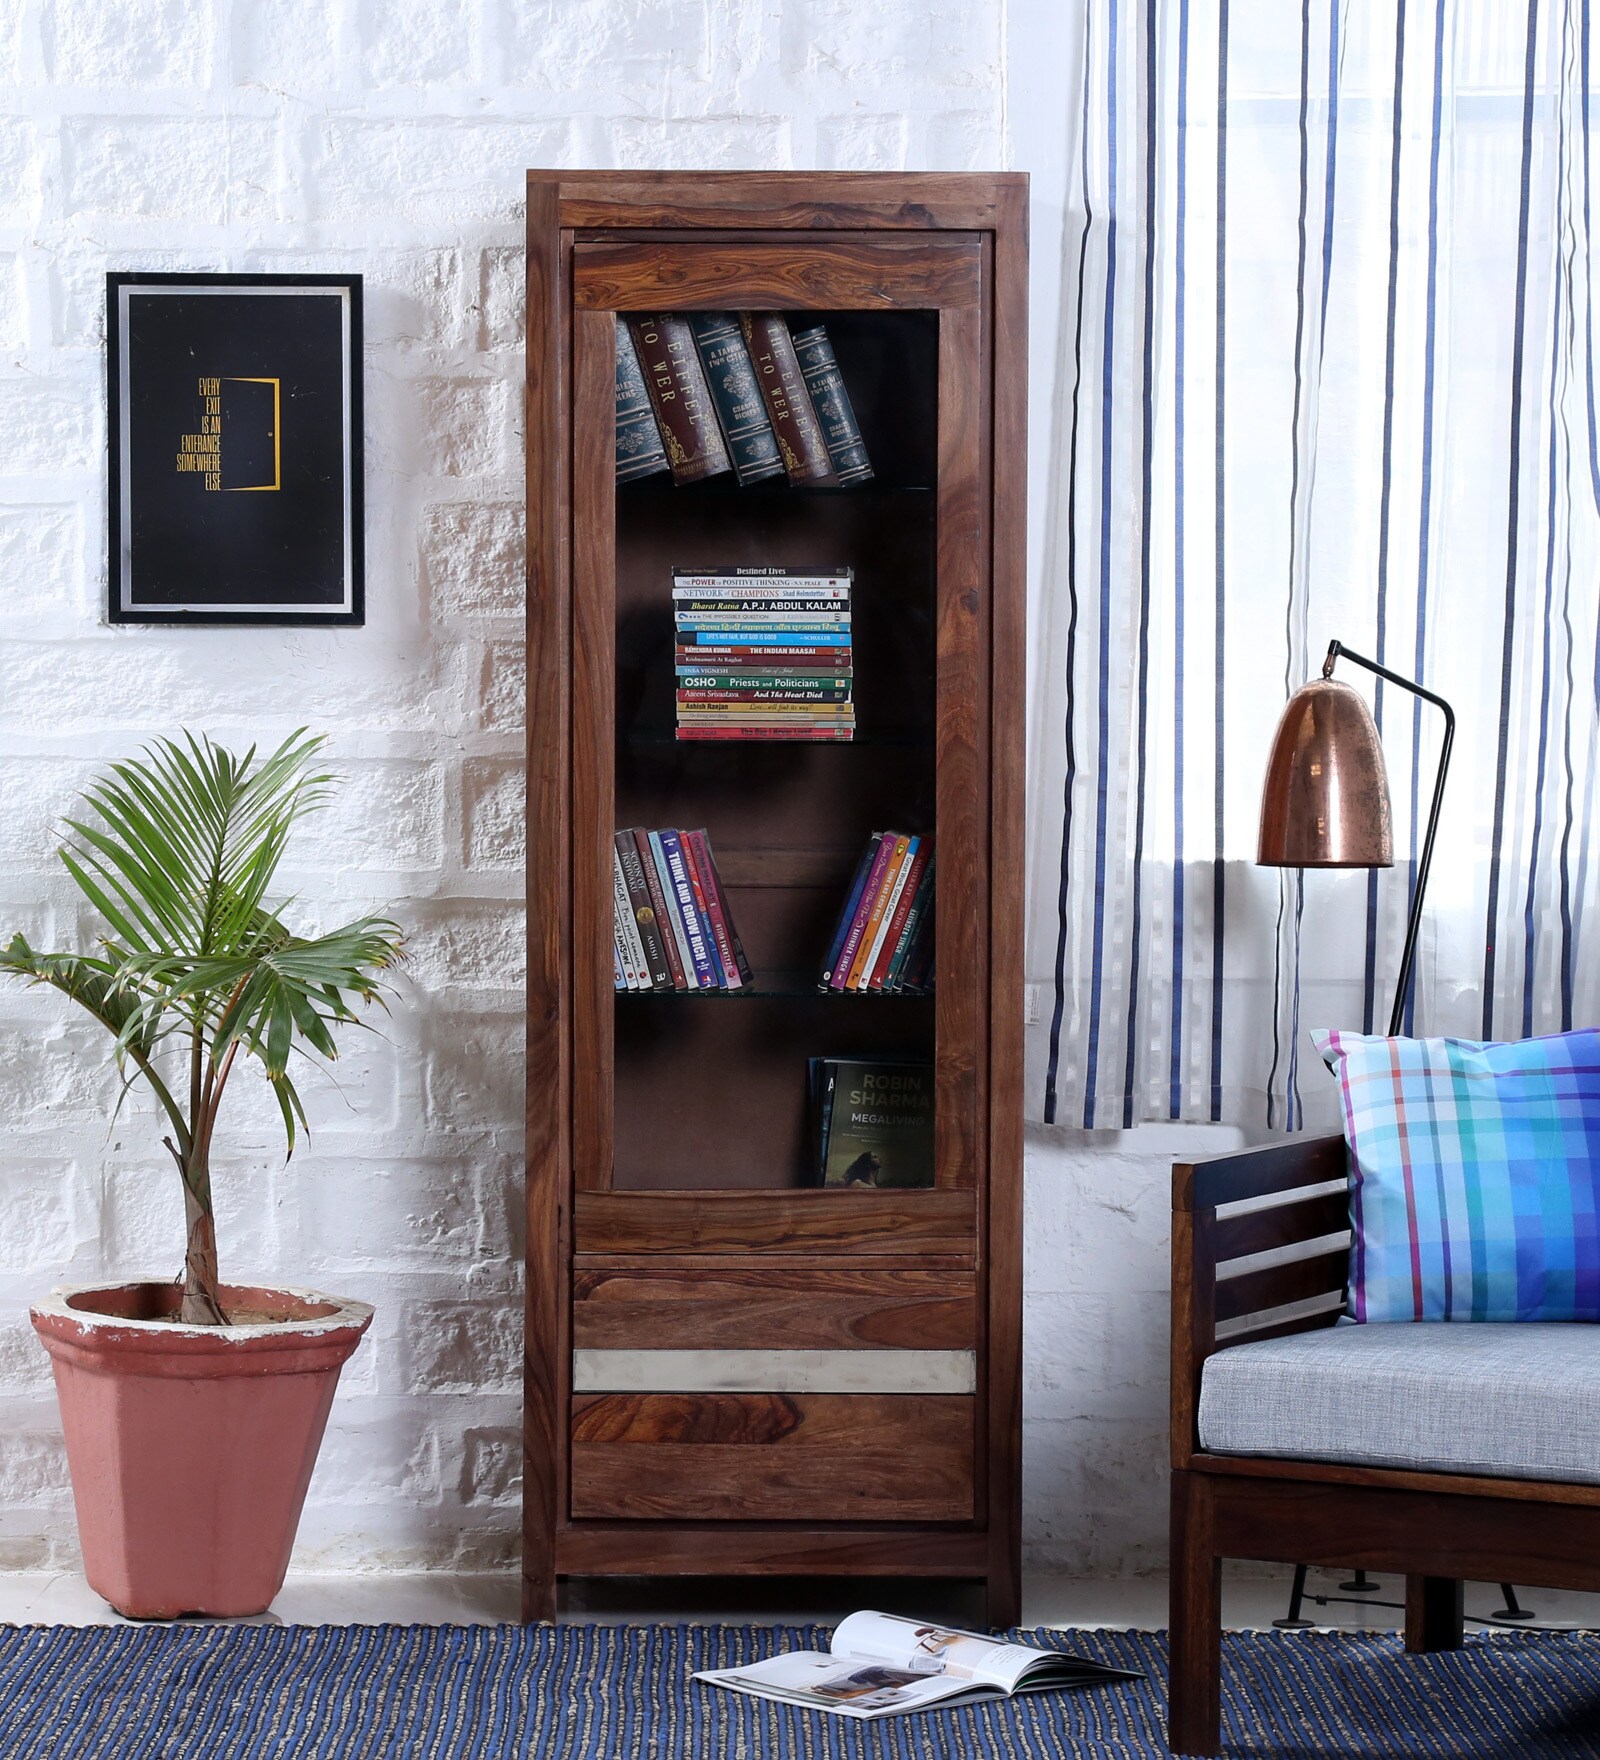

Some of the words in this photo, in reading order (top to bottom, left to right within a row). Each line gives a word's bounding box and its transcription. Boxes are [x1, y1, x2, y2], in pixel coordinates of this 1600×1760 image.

[199, 378, 220, 395] EVERY
[668, 342, 702, 424] EIFFEL
[768, 326, 786, 358] THE
[782, 371, 811, 438] EIFFEL
[206, 397, 220, 414] EXIT
[202, 416, 209, 434] IS
[210, 416, 220, 434] AN
[182, 435, 221, 452] ENTERANCE
[177, 454, 221, 471] SOMEWHERE
[205, 473, 221, 490] ELSE
[731, 590, 779, 598] CHAMPIONS
[742, 602, 768, 610] A.P.J.
[770, 602, 804, 610] ABDUL
[806, 602, 841, 610] KALAM
[685, 678, 716, 686] OSHO
[730, 678, 759, 686] Priests
[775, 679, 819, 687] Politicians
[622, 852, 638, 893] IKSHVAKU
[630, 851, 642, 877] SCION
[637, 878, 646, 889] OF
[669, 851, 686, 883] THINK
[693, 835, 704, 869] CHETAN
[702, 870, 712, 900] BHAGAT
[903, 857, 911, 872] Great
[896, 873, 906, 888] Work,
[676, 883, 691, 904] AND
[891, 889, 900, 903] Great
[682, 905, 700, 935] GROW
[884, 904, 894, 921] Career
[894, 907, 905, 930] RICHES
[701, 911, 710, 933] facebook
[902, 909, 916, 935] RAVINDER
[616, 935, 631, 965] AWESOME
[624, 924, 635, 939] point
[631, 942, 641, 969] someone
[647, 935, 658, 960] AMISH
[691, 935, 706, 960] RICH
[846, 928, 860, 954] RAVINDER
[895, 937, 906, 954] SINGH
[839, 956, 850, 972] SINGH
[863, 1074, 918, 1090] ROBIN
[850, 1090, 930, 1108] SHARMA
[851, 1113, 925, 1125] MEGALIVING
